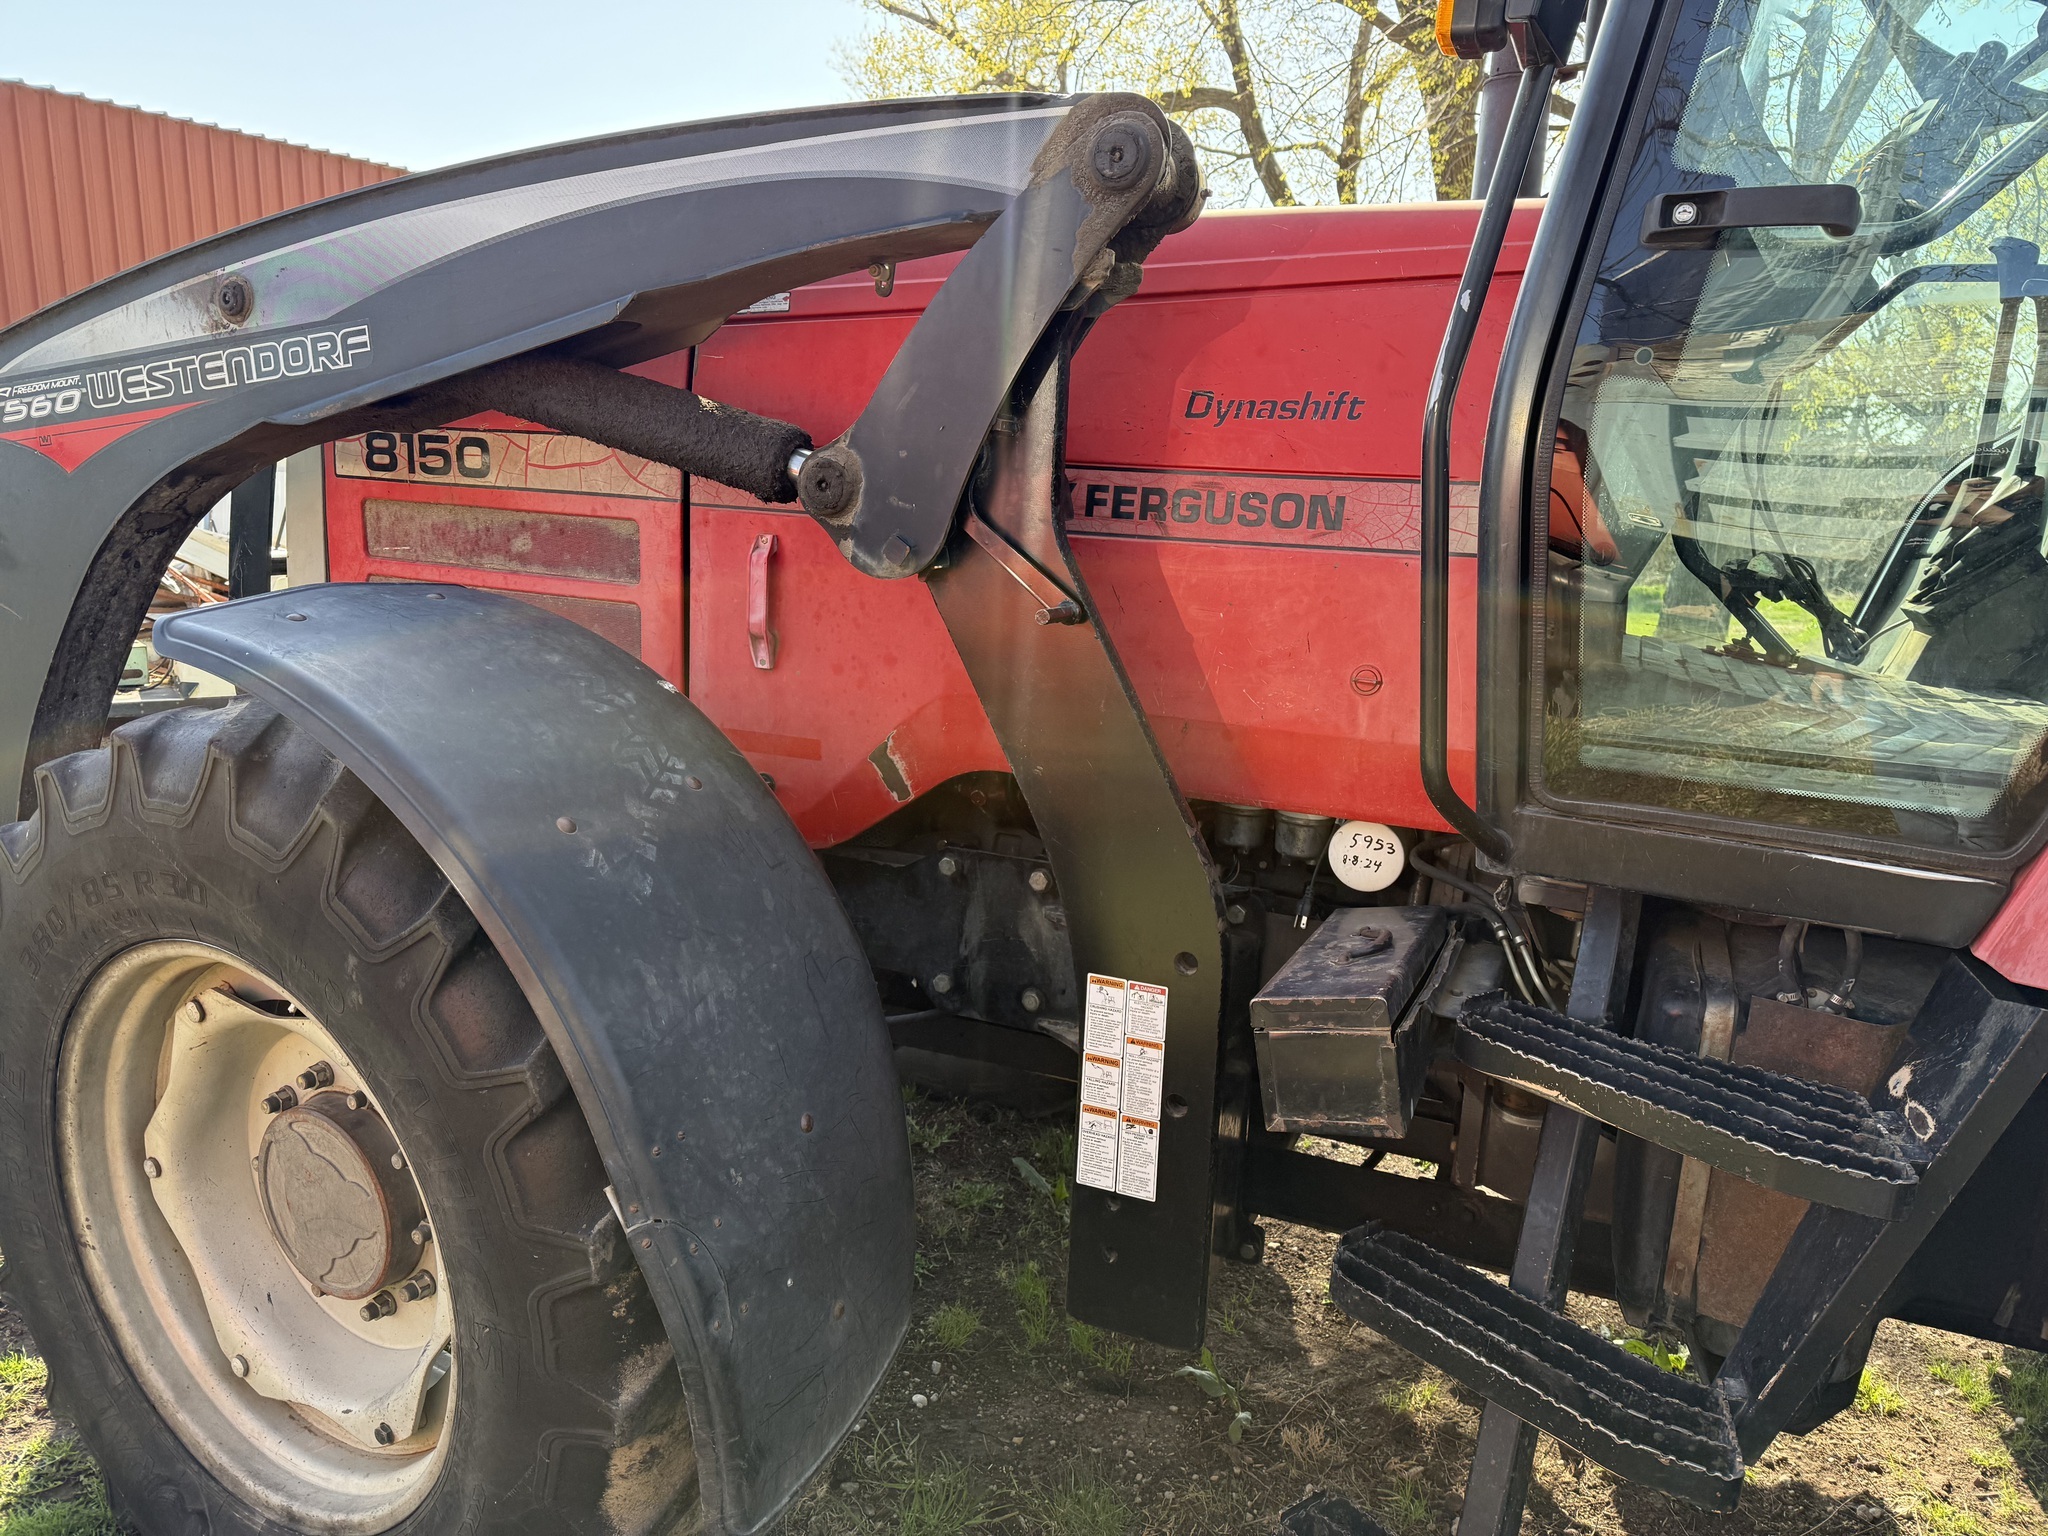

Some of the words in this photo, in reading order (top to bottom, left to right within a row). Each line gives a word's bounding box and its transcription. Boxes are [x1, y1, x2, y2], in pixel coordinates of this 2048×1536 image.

[86, 324, 371, 409] WESTENDORF
[12, 383, 50, 396] FREEDOM
[3, 389, 81, 423] 560
[1184, 390, 1365, 427] Dynashift
[366, 432, 490, 478] 8150
[1084, 484, 1346, 531] FERGUSON
[1350, 833, 1396, 854] 5953
[1096, 978, 1123, 988] WARNING
[1140, 985, 1162, 994] DANGER
[1136, 1039, 1159, 1049] WARNING
[1092, 1056, 1119, 1066] WARNING
[1089, 1107, 1116, 1117] WARNING
[1131, 1118, 1155, 1127] WARNING
